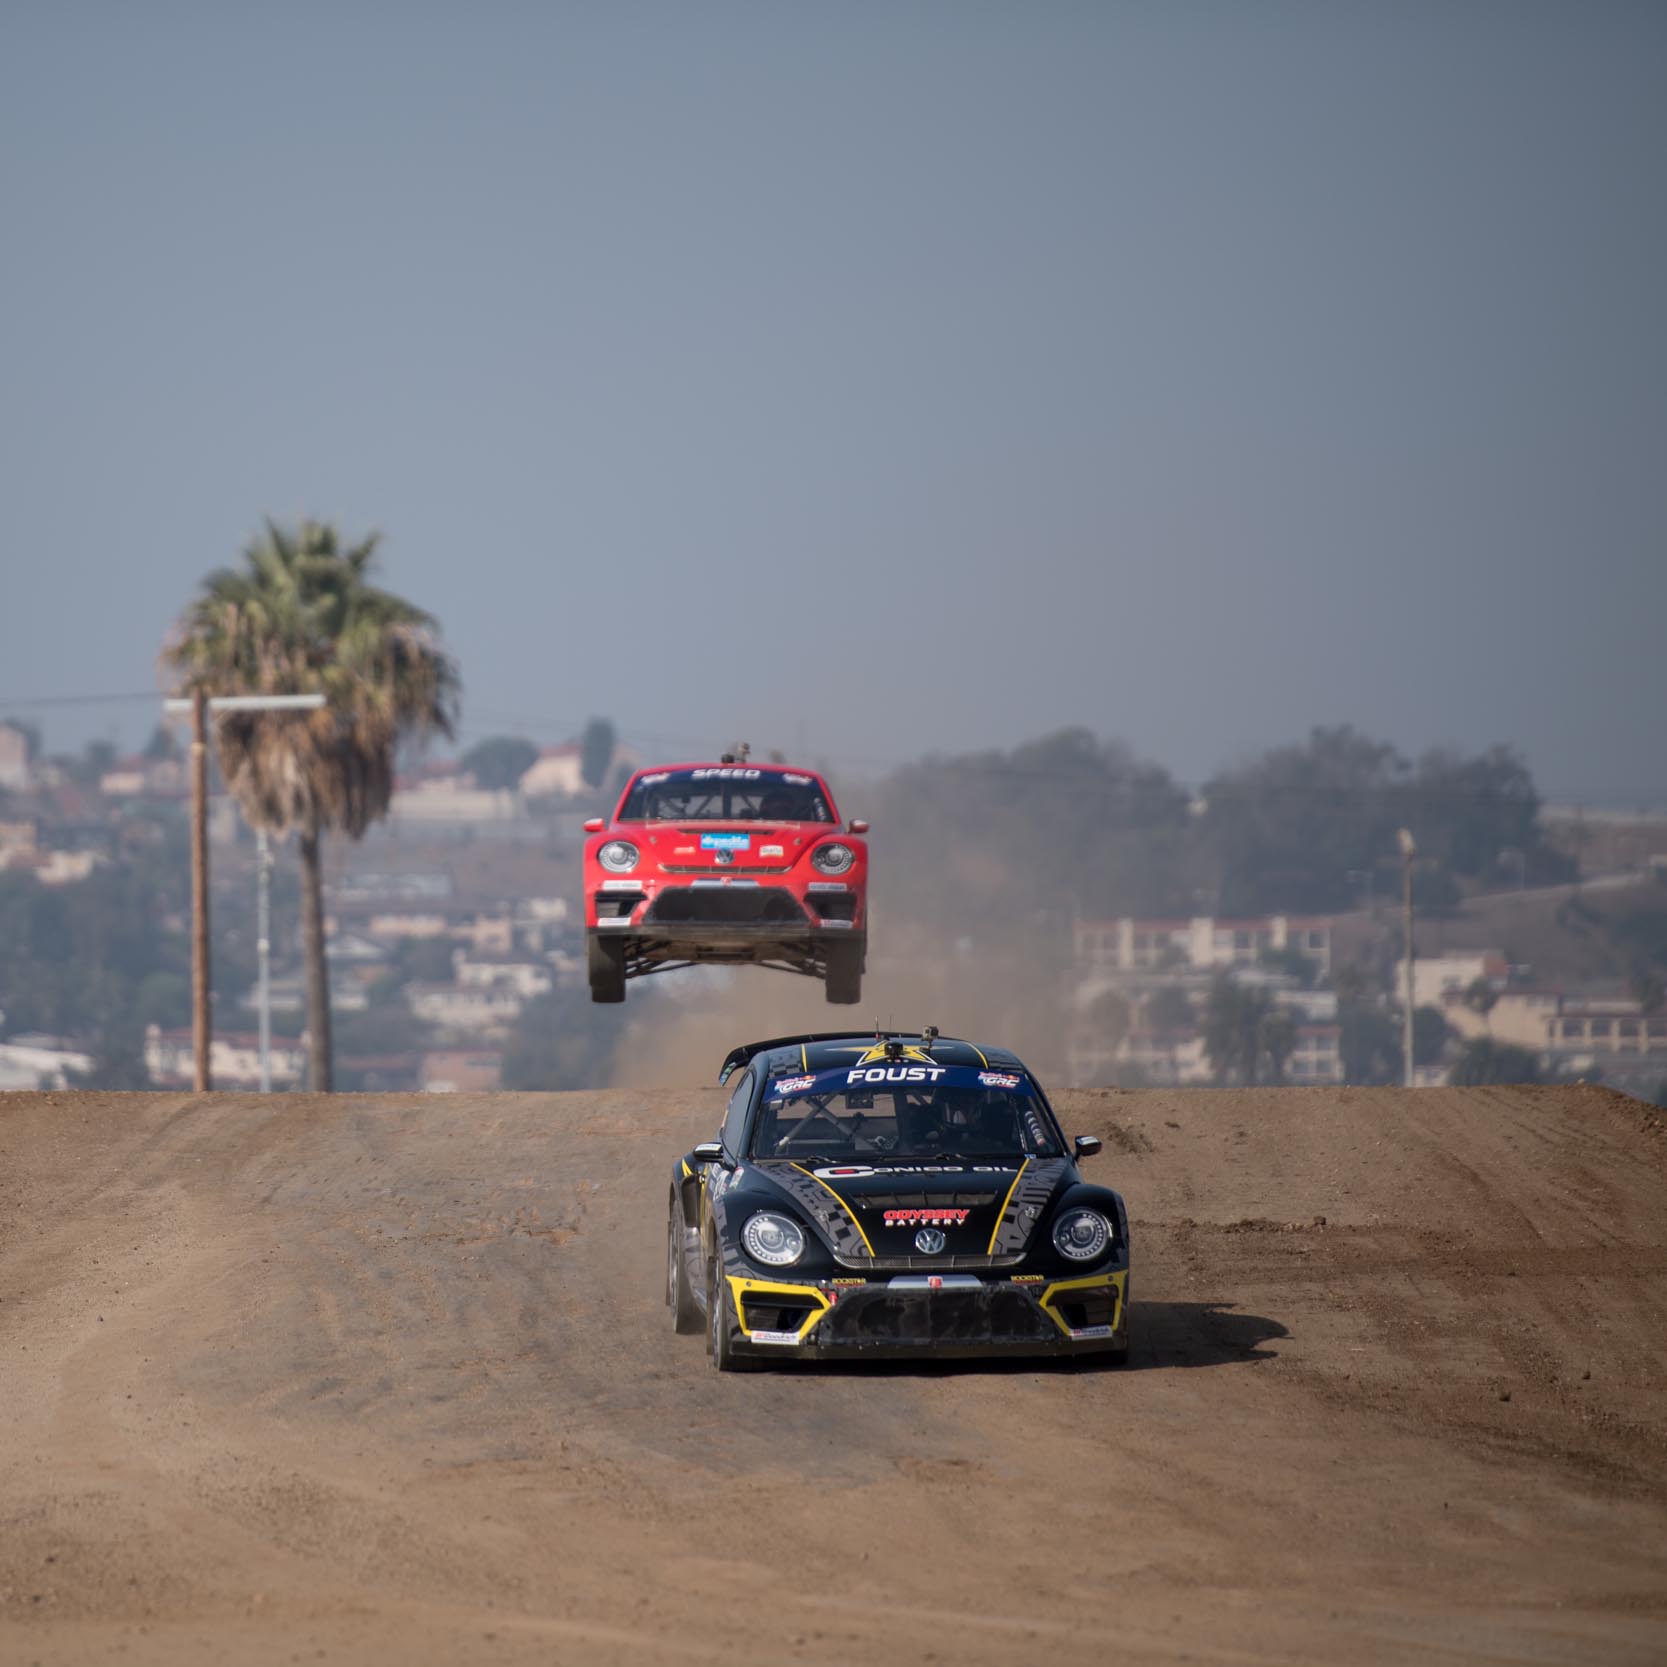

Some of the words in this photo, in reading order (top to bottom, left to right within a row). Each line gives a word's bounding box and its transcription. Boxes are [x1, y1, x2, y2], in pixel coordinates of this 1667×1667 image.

[691, 768, 761, 778] SPEED
[847, 1067, 946, 1084] FOUST
[883, 1208, 970, 1219] ODYSSEY
[885, 1218, 965, 1226] BATTERY
